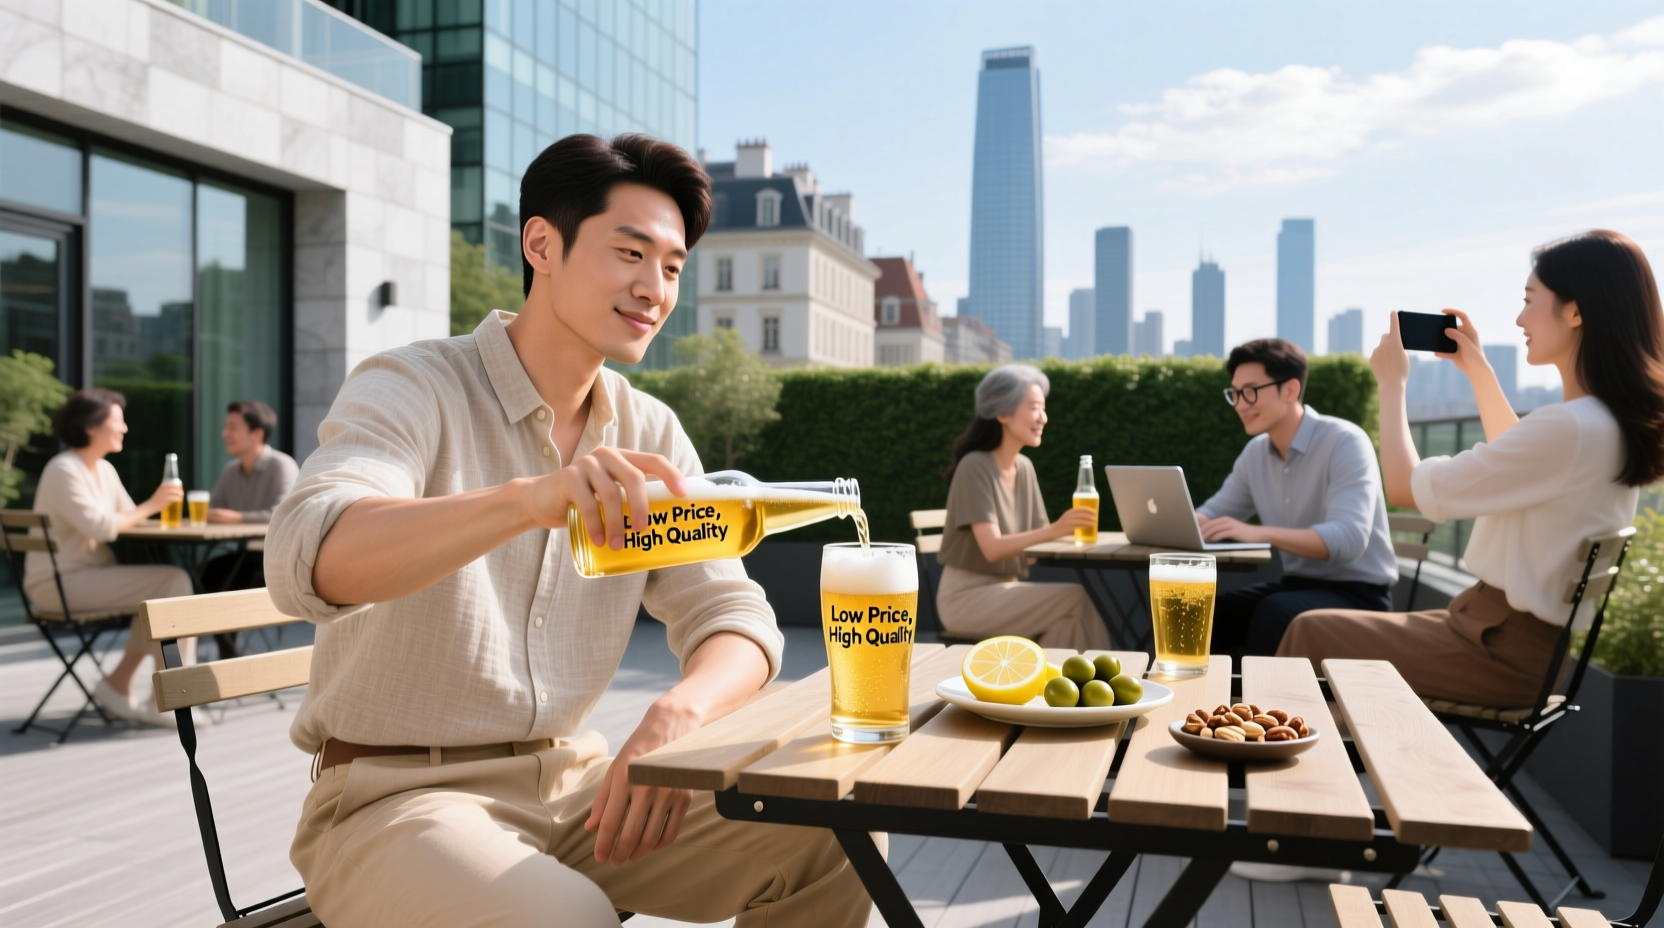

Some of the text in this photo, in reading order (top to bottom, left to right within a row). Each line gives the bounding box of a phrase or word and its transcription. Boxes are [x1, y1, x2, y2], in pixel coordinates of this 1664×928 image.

[672, 503, 721, 523] Price,
[624, 522, 728, 551] High Quality
[831, 605, 912, 625] Low Price,
[829, 626, 912, 648] High Quality
